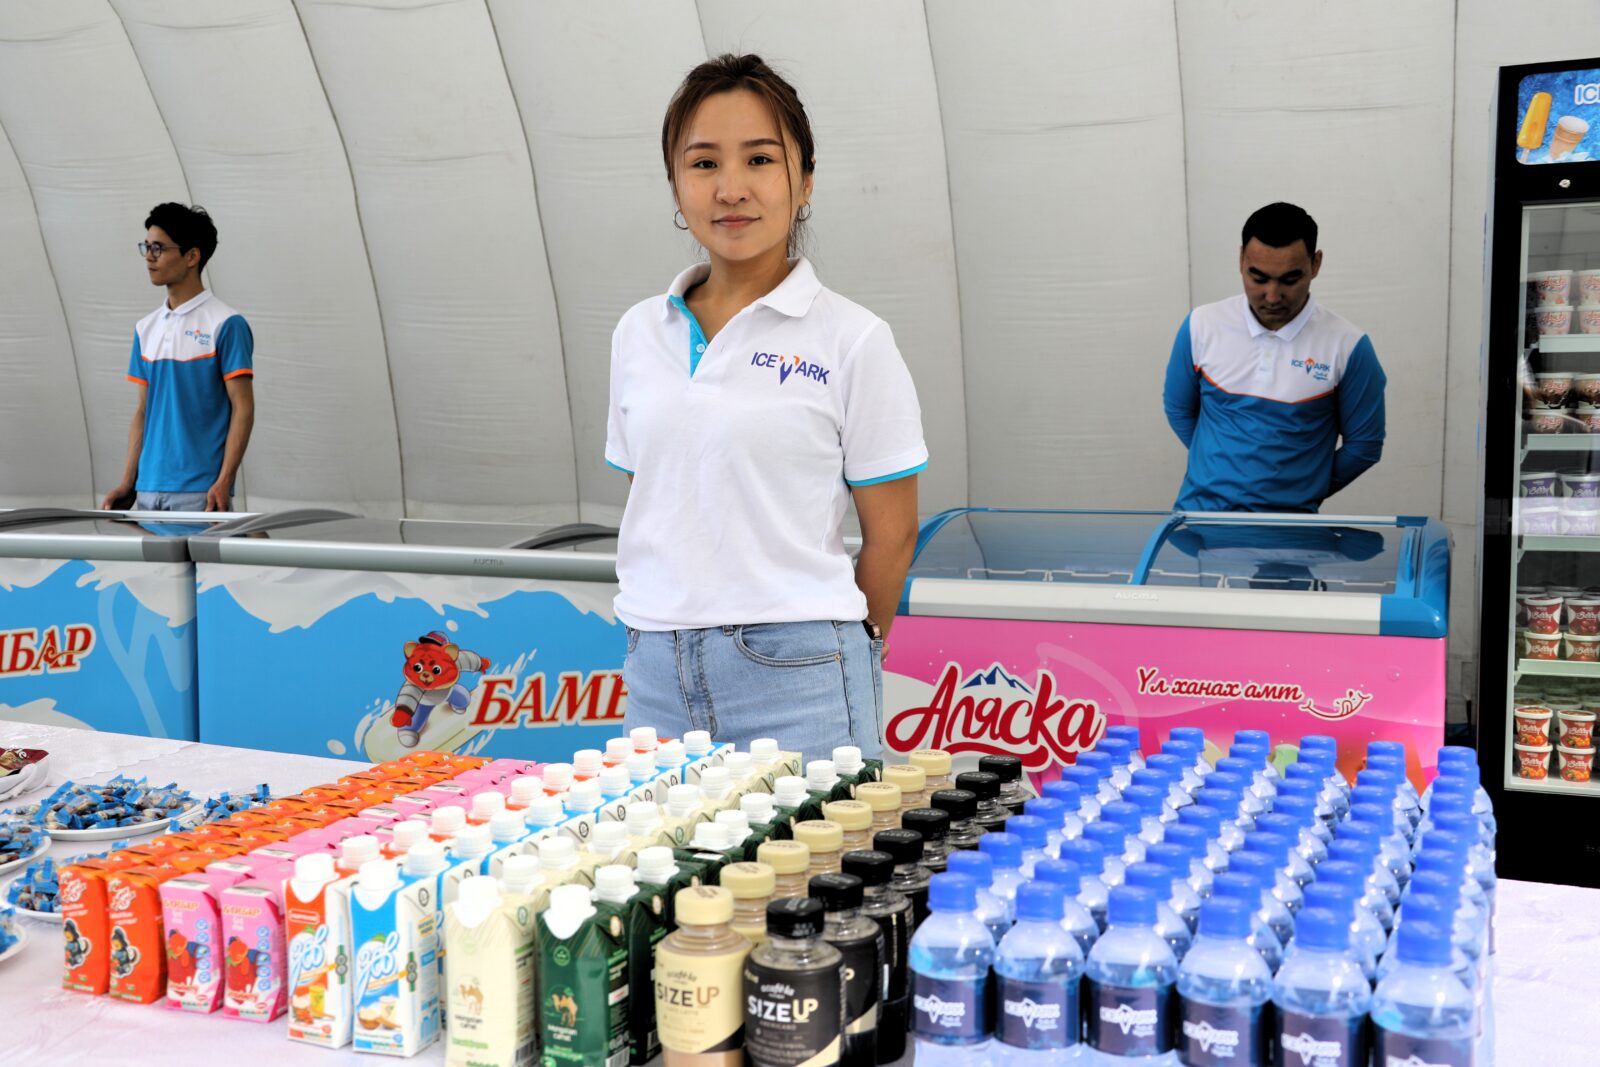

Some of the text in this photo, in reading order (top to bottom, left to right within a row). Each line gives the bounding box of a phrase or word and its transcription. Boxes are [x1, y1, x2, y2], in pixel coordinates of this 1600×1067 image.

[1575, 84, 1600, 105] IC
[751, 352, 778, 368] ICE
[0, 627, 92, 674] БАР
[1171, 679, 1241, 697] ханах
[1244, 682, 1301, 700] амт
[885, 665, 1103, 764] Аляска
[657, 981, 720, 1008] SIZE UP
[747, 994, 819, 1023] SIZE UP
